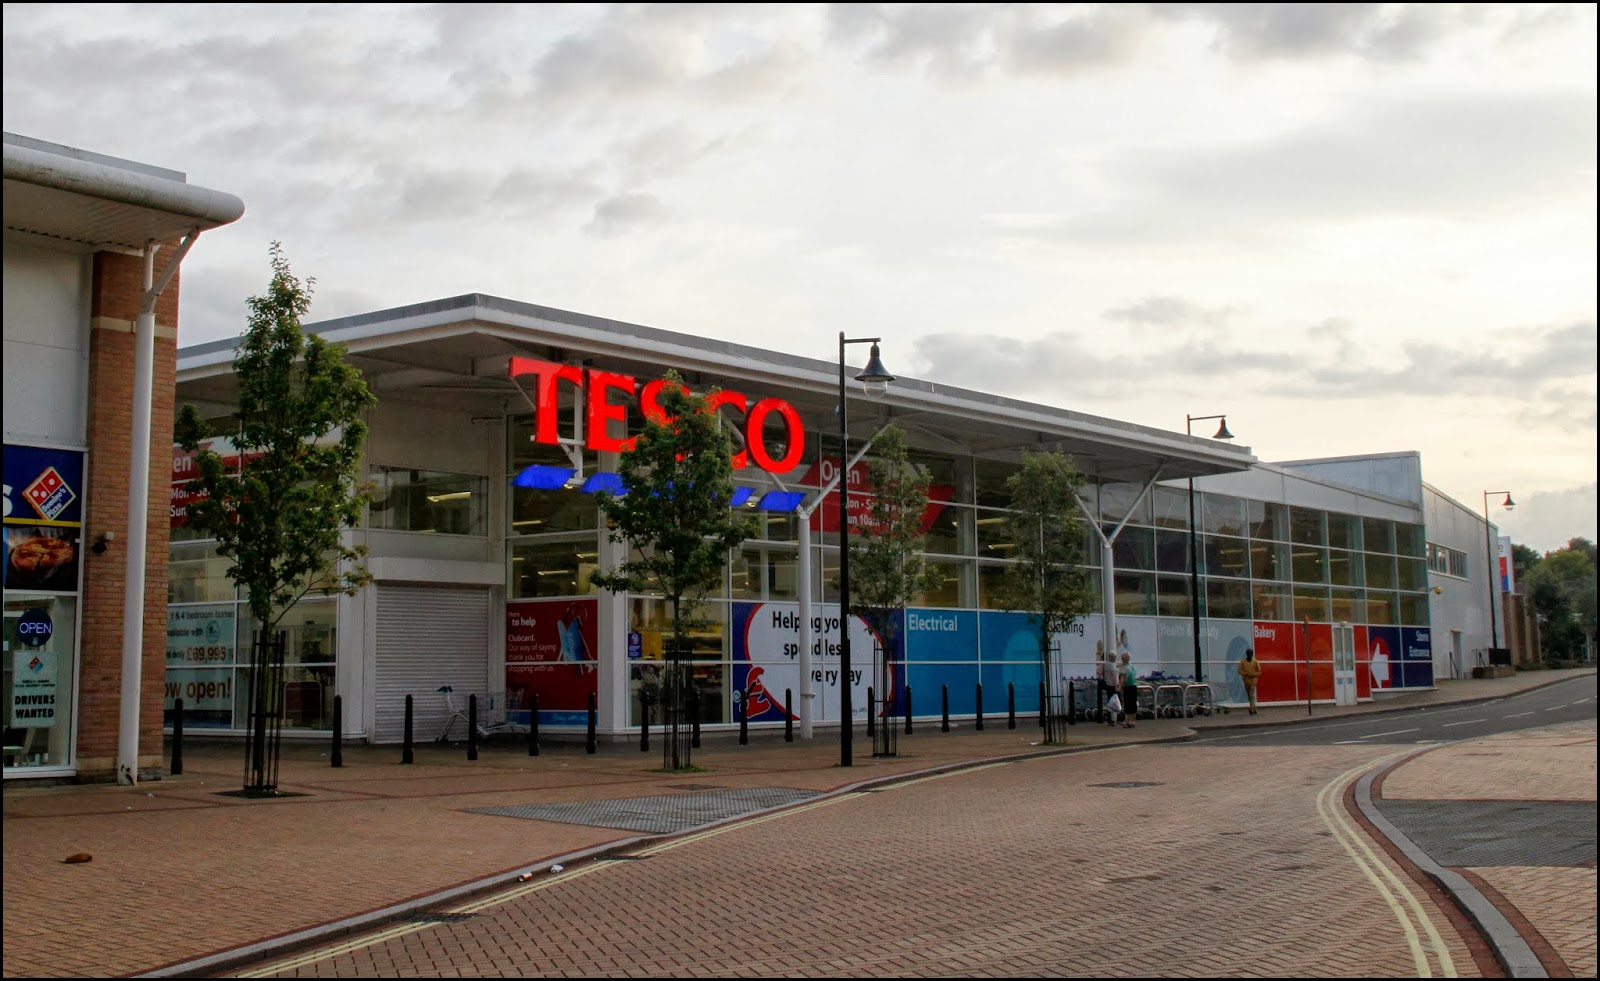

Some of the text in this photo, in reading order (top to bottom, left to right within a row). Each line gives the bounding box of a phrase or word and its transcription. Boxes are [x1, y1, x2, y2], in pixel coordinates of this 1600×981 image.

[173, 456, 193, 473] en
[821, 460, 860, 484] On
[41, 487, 67, 512] Domino's
[46, 503, 63, 518] Pizza
[847, 514, 859, 525] un
[187, 611, 213, 620] bedroom
[772, 610, 822, 633] Helpg
[824, 616, 842, 633] yo
[19, 622, 52, 634] OPEN
[512, 616, 536, 628] to help
[909, 613, 958, 632] Electrical
[167, 628, 204, 637] vailable with
[1050, 620, 1084, 637] loing
[1160, 623, 1219, 640] Health & eauty
[1254, 625, 1276, 641] Bakery
[508, 633, 536, 642] Clubcard.
[1416, 631, 1429, 642] Store
[508, 643, 557, 653] Our way of saying
[783, 639, 842, 660] spd les
[1409, 646, 1430, 657] Entrance
[171, 650, 185, 660] only
[508, 653, 545, 663] thank you for
[508, 664, 533, 674] shopping
[533, 664, 547, 672] with
[811, 669, 862, 687] very ay
[164, 677, 232, 704] ow open!
[15, 695, 55, 705] DRIVERS
[16, 708, 54, 719] WANTED
